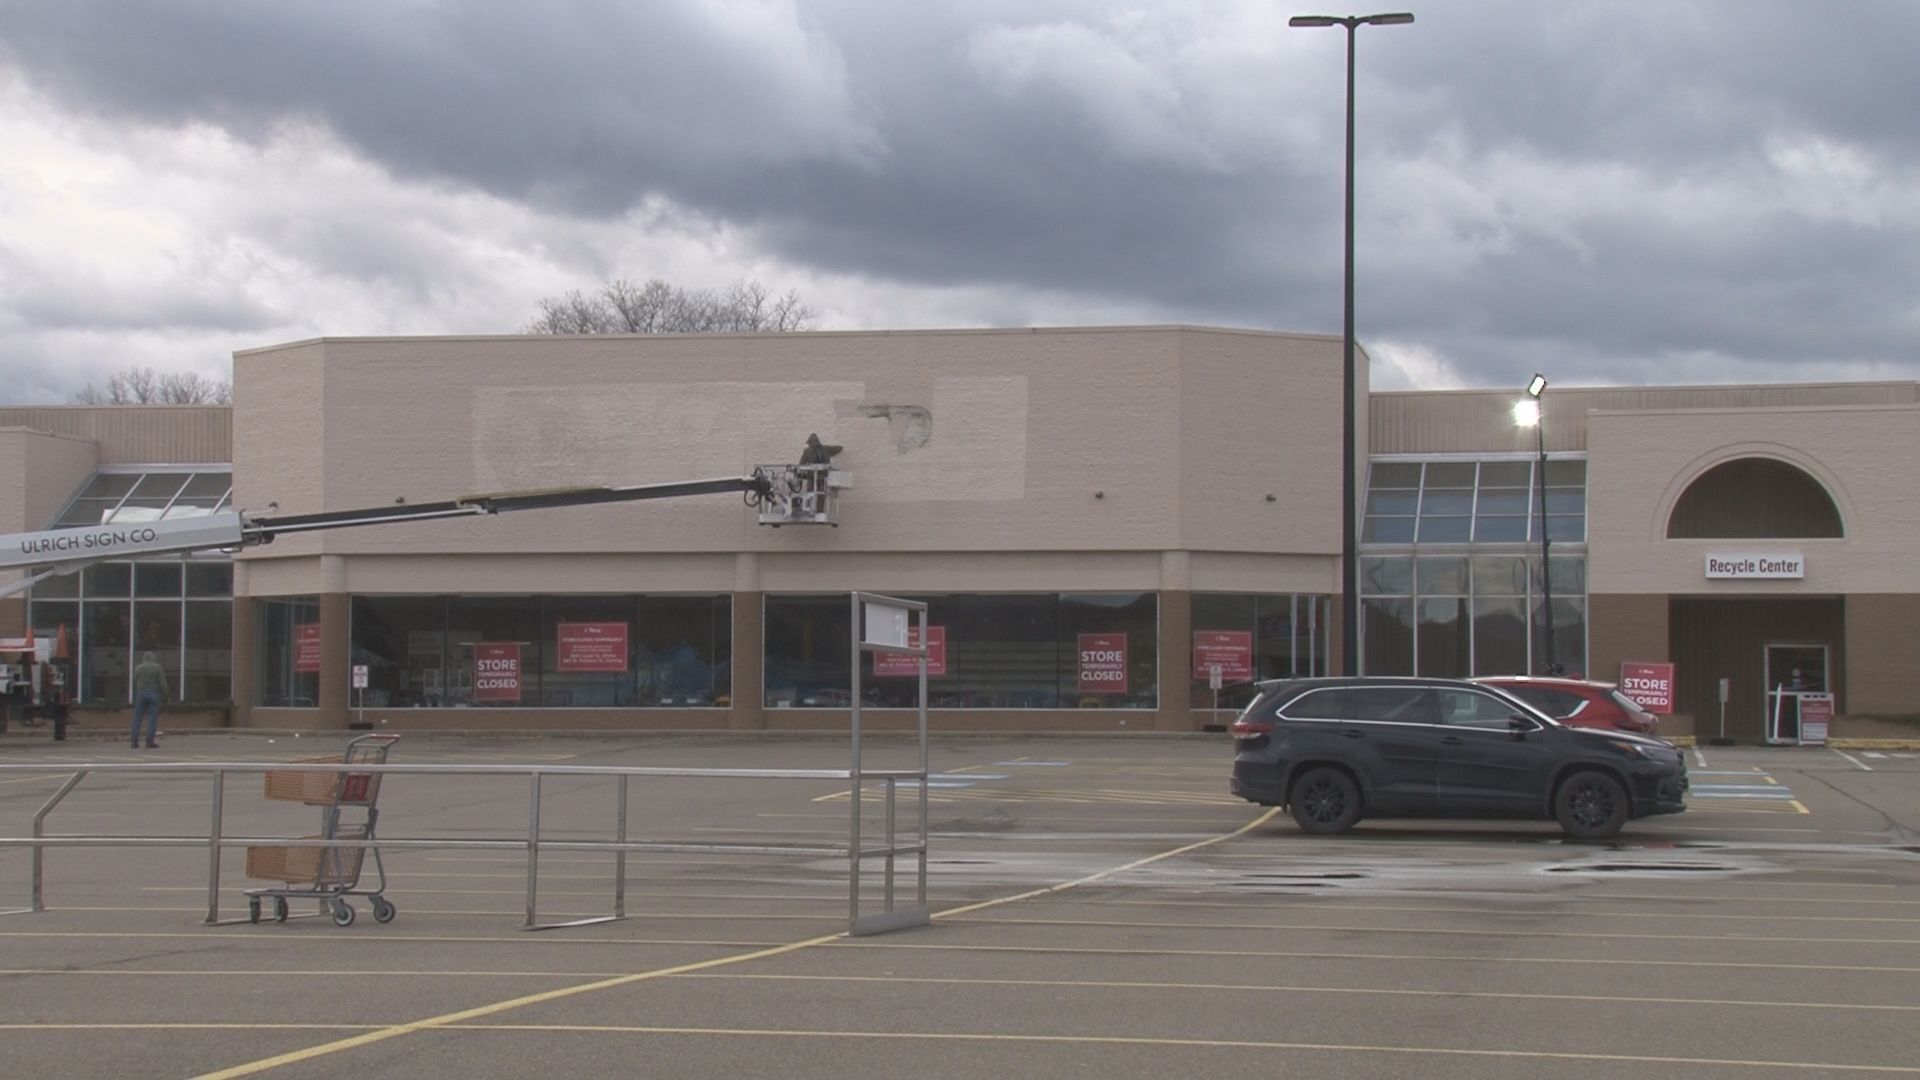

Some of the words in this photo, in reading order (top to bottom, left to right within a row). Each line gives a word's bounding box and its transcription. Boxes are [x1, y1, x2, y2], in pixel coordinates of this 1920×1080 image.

[21, 537, 79, 554] ULRICH
[84, 532, 126, 548] SIGN
[130, 528, 159, 543] CO.
[1709, 558, 1755, 575] Recycle
[1759, 558, 1799, 573] Center
[1081, 651, 1123, 662] STORE
[477, 659, 517, 670] STORE
[1081, 671, 1123, 681] CLOSED
[477, 679, 518, 689] CLOSED
[1624, 678, 1668, 690] STORE
